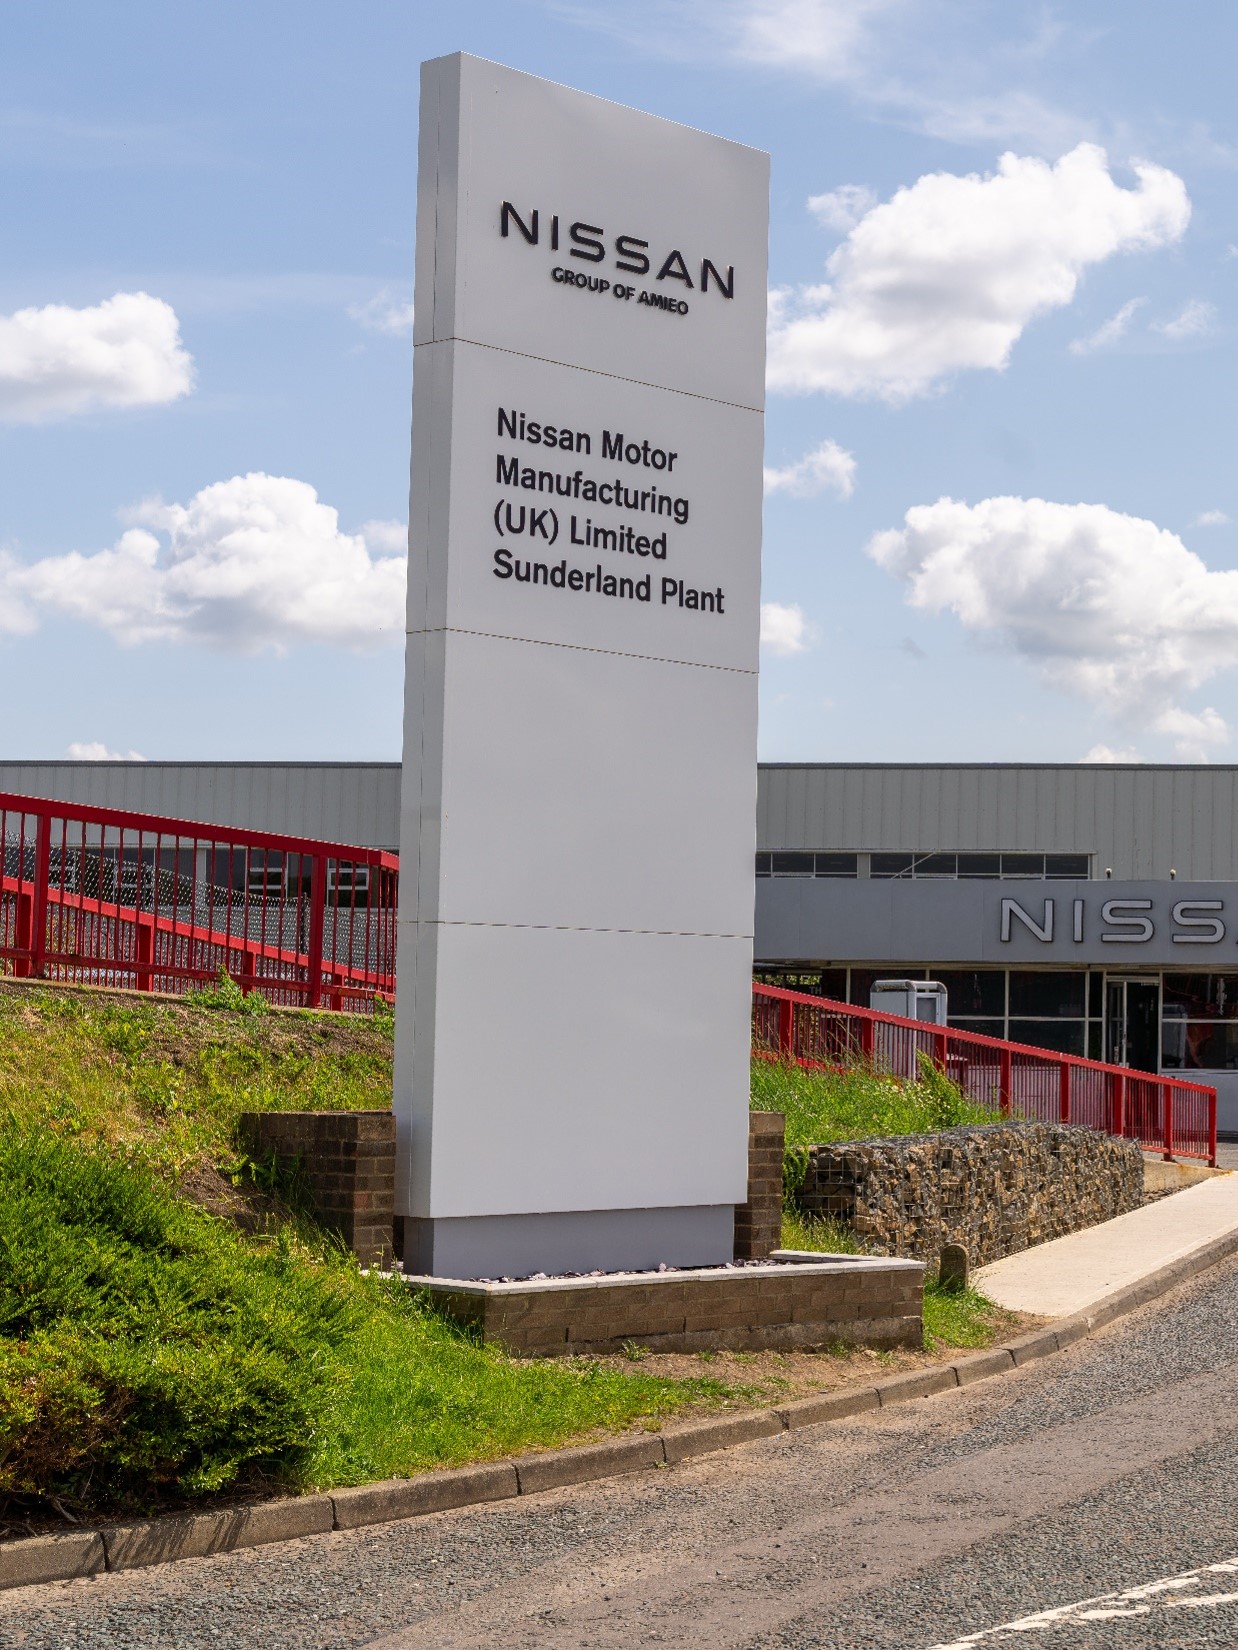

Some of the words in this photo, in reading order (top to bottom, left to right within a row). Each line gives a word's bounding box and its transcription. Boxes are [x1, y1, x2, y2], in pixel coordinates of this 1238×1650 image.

[500, 201, 736, 300] NISSAN
[551, 266, 610, 293] GROUP
[612, 283, 636, 301] OF
[637, 290, 689, 315] AMIEO
[496, 407, 591, 455] Nissan
[602, 429, 678, 473] Motor
[496, 454, 689, 525] Manufacturing
[493, 498, 559, 546] (UK)
[571, 515, 668, 560] Limited
[493, 548, 651, 602] Sunderland
[661, 576, 725, 614] Plant
